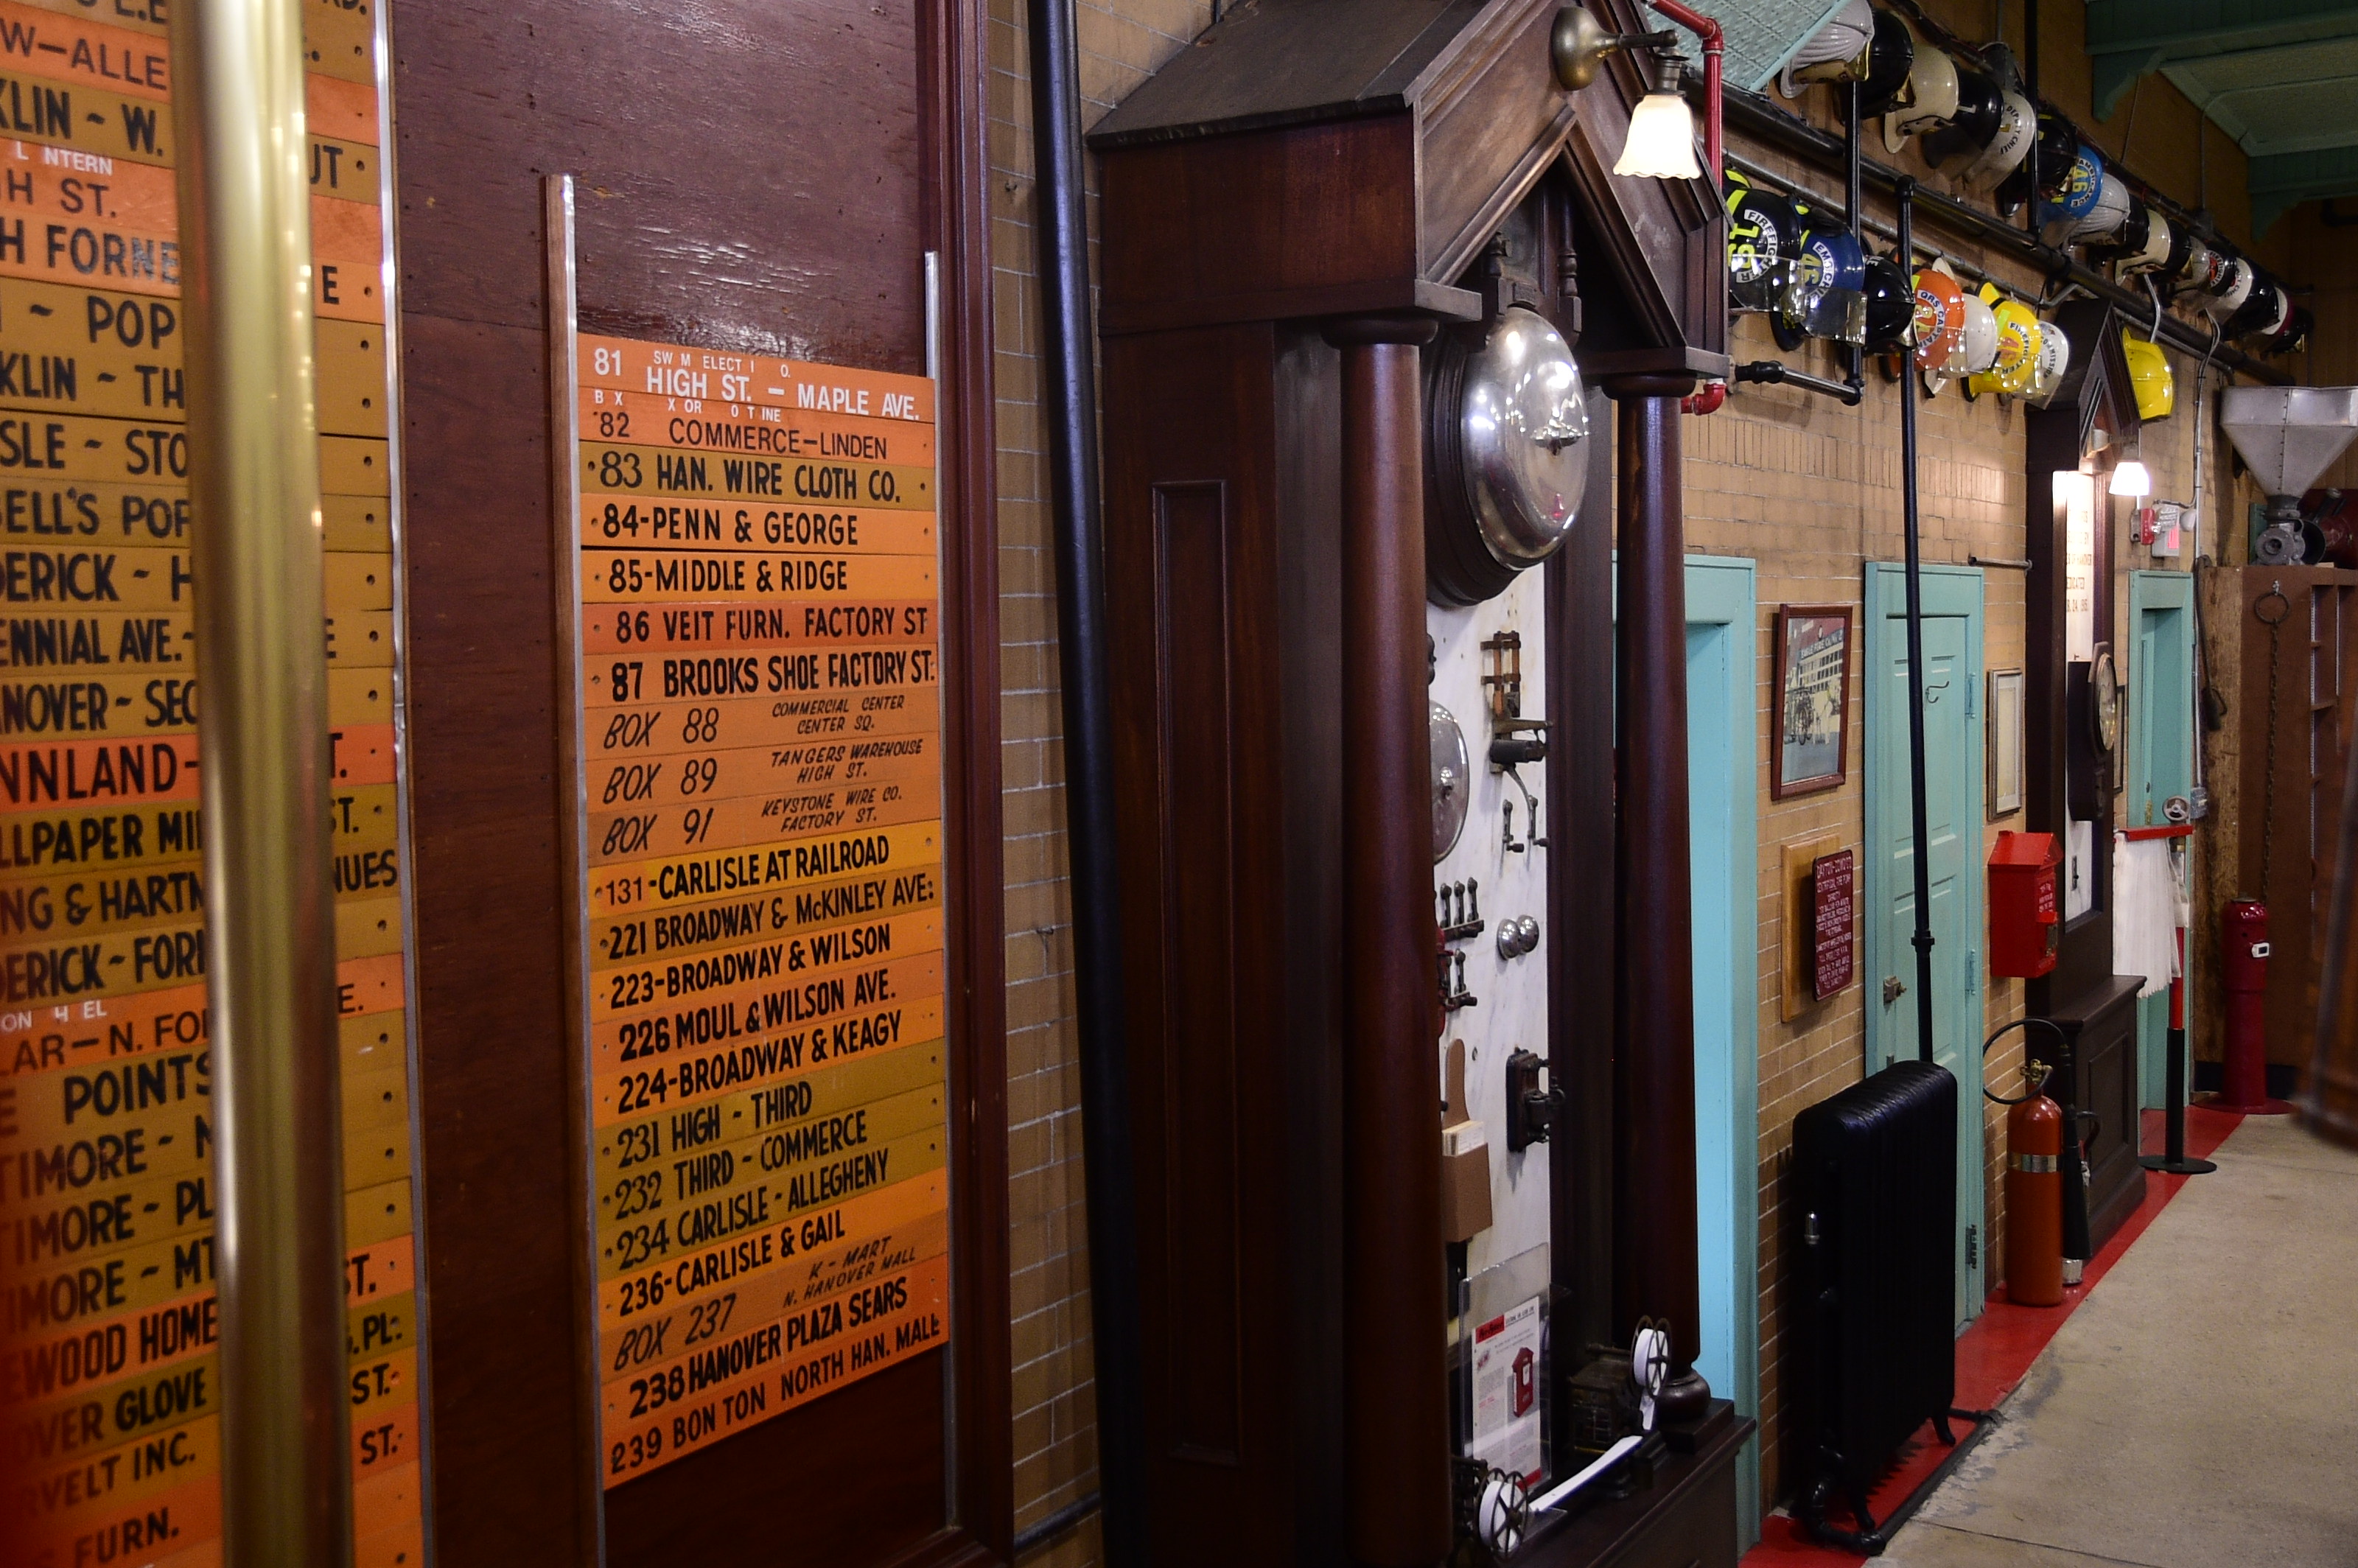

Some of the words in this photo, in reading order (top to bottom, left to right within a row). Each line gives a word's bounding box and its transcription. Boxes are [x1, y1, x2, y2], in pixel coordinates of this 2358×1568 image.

[60, 178, 116, 218] ST.
[1920, 291, 1940, 308] QRS
[593, 348, 622, 377] 81
[647, 366, 707, 400] HIGH
[721, 375, 752, 402] ST.
[797, 382, 869, 416] MAPLE
[882, 393, 920, 421] AVE.
[600, 411, 629, 438] 82
[601, 451, 643, 489] 83
[657, 454, 713, 491] HAN.
[724, 459, 782, 495] WIRE
[794, 465, 857, 501] CLOTH
[869, 469, 900, 503] CO.
[735, 511, 752, 544] &
[764, 511, 858, 545] GEORGE
[0, 552, 119, 603] ERICK
[756, 560, 774, 592] &
[781, 560, 847, 591] RIDGE
[616, 610, 650, 643] 86
[664, 610, 714, 642] VEIT
[726, 609, 790, 641] FURN.
[805, 606, 895, 638] FACTORY
[612, 662, 643, 701] 87
[664, 657, 758, 698] BROOKS
[767, 654, 819, 692] SHOE
[828, 651, 908, 687] FACTORY
[604, 711, 660, 749] BOX
[682, 707, 719, 743] 88
[772, 699, 850, 718] COMMERCIAL
[861, 695, 904, 710] CENTER
[797, 718, 845, 735] CENTER
[854, 715, 875, 731] SQ.
[603, 763, 662, 805] BOX
[680, 757, 718, 795] 89
[772, 746, 846, 769] TANGERS
[850, 739, 923, 760] WAREHOUSE
[797, 766, 833, 783] HIGH
[846, 762, 867, 778] ST.
[602, 814, 657, 855] BOX
[684, 808, 714, 845] 91
[761, 793, 834, 818] KEYSTONE
[845, 788, 876, 806] WIRE
[882, 785, 902, 802] CO.
[780, 812, 844, 833] FACTORY
[856, 807, 877, 823] ST.
[766, 850, 792, 884] AT
[797, 836, 889, 878] RAILROAD
[609, 921, 646, 959] 221
[654, 900, 765, 951] BROADWAY
[772, 897, 788, 930] &
[797, 881, 886, 924] McKINLEY
[892, 872, 934, 907] AVE.
[0, 943, 104, 1003] ERICK
[788, 940, 805, 972] &
[811, 923, 890, 966] WILSON
[619, 1018, 671, 1062] 226
[675, 1008, 741, 1049] MOUL
[746, 1001, 762, 1033] &
[764, 979, 844, 1027] WILSON
[854, 968, 896, 1008] AVE.
[811, 1029, 828, 1063] &
[833, 1009, 902, 1057] KEAGY
[618, 1121, 660, 1169] 231
[671, 1105, 721, 1152] HIGH
[751, 1080, 811, 1129] THIRD
[615, 1171, 662, 1220] 232
[674, 1150, 735, 1200] THIRD
[760, 1110, 867, 1172] COMMERCE
[617, 1219, 669, 1270] 234
[678, 1186, 769, 1247] CARLISLE
[788, 1148, 889, 1213] ALLEGHENY
[780, 1227, 794, 1256] &
[801, 1210, 845, 1251] GAIL
[809, 1261, 822, 1281] K
[842, 1236, 892, 1269] MART
[614, 1317, 671, 1371] BOX
[685, 1292, 736, 1346] 237
[783, 1290, 798, 1308] N.
[804, 1261, 875, 1301] HANOVER
[881, 1247, 916, 1274] MALL
[629, 1369, 685, 1419] 238
[689, 1324, 781, 1395] HANOVER
[786, 1301, 843, 1353] PLAZA
[849, 1276, 907, 1327] SEARS
[114, 1366, 207, 1432] GLOVE
[351, 1363, 391, 1405] ST.
[611, 1427, 662, 1474] 239
[673, 1409, 716, 1449] BON
[724, 1382, 766, 1426] TON
[780, 1350, 844, 1401] NORTH
[851, 1334, 890, 1371] HAN.
[896, 1313, 940, 1351] MALL
[133, 1431, 196, 1483] INC.
[360, 1424, 398, 1465] ST.
[74, 1507, 180, 1565] FURN.
